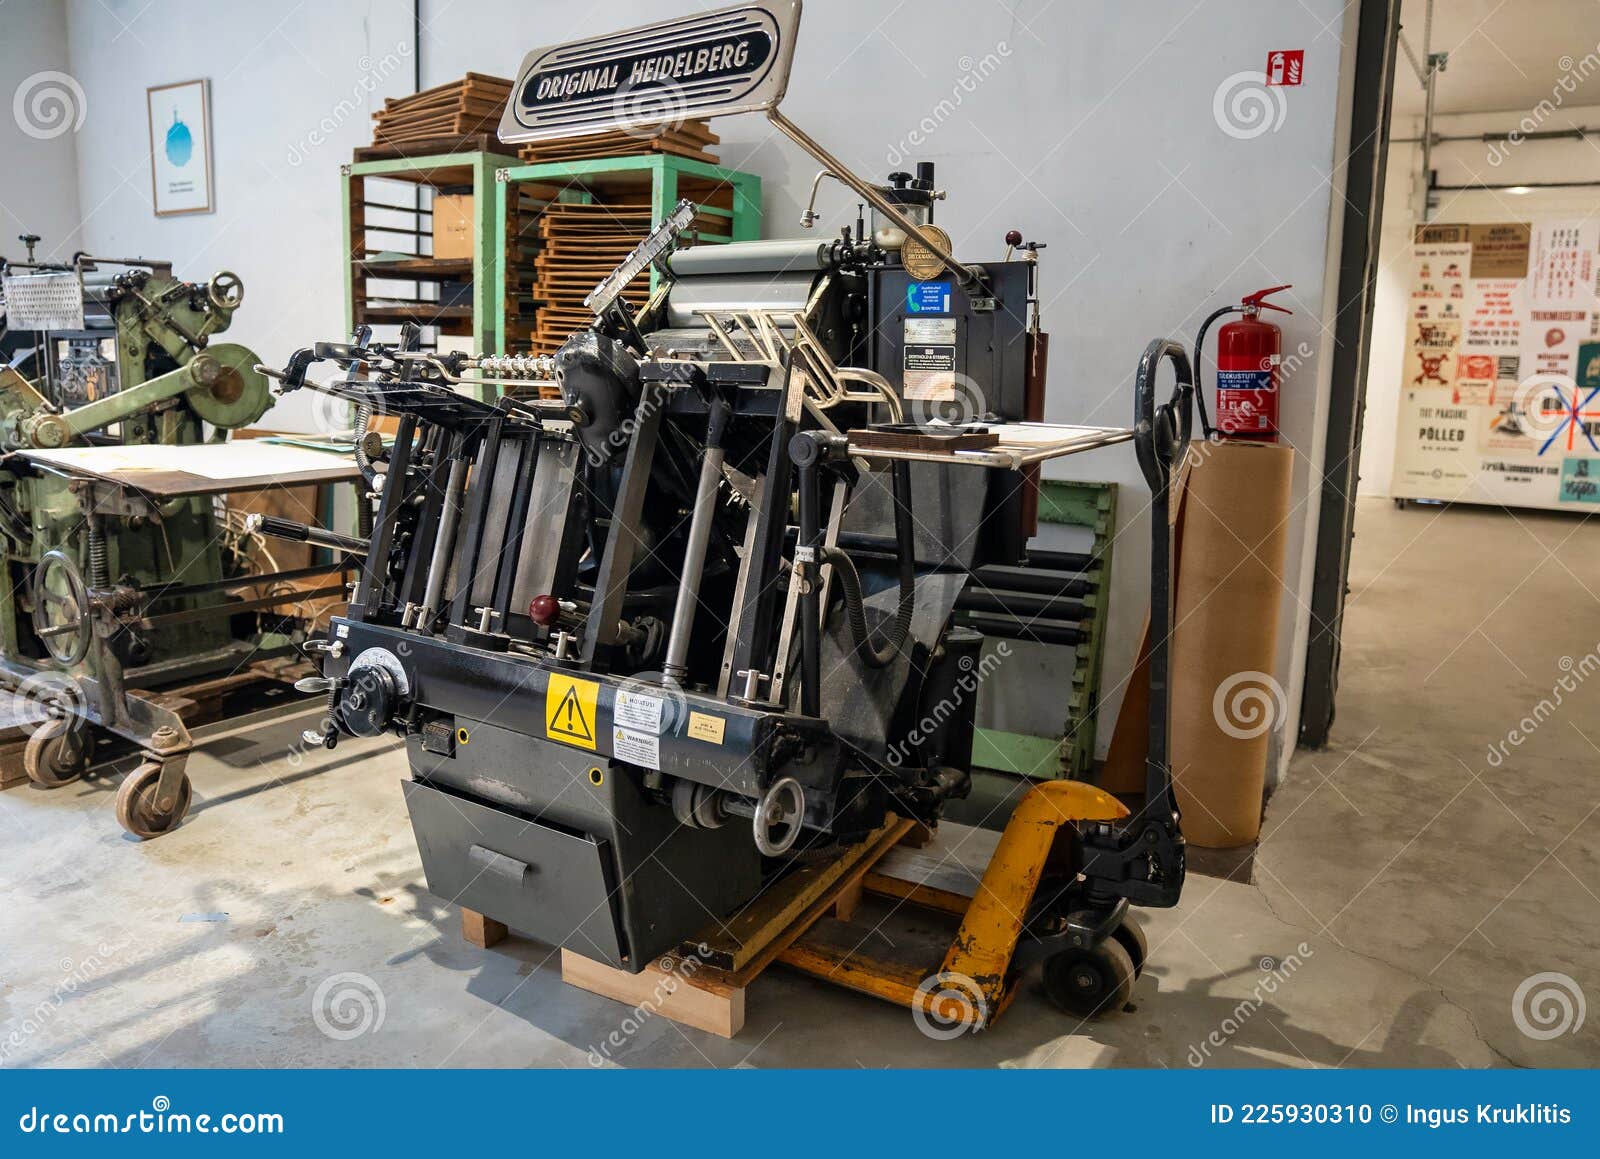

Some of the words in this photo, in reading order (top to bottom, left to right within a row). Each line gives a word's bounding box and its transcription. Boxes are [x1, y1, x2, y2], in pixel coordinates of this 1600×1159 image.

[536, 66, 618, 100] ORIGINAL
[628, 41, 749, 84] HEIDELBERG
[497, 168, 510, 182] 26
